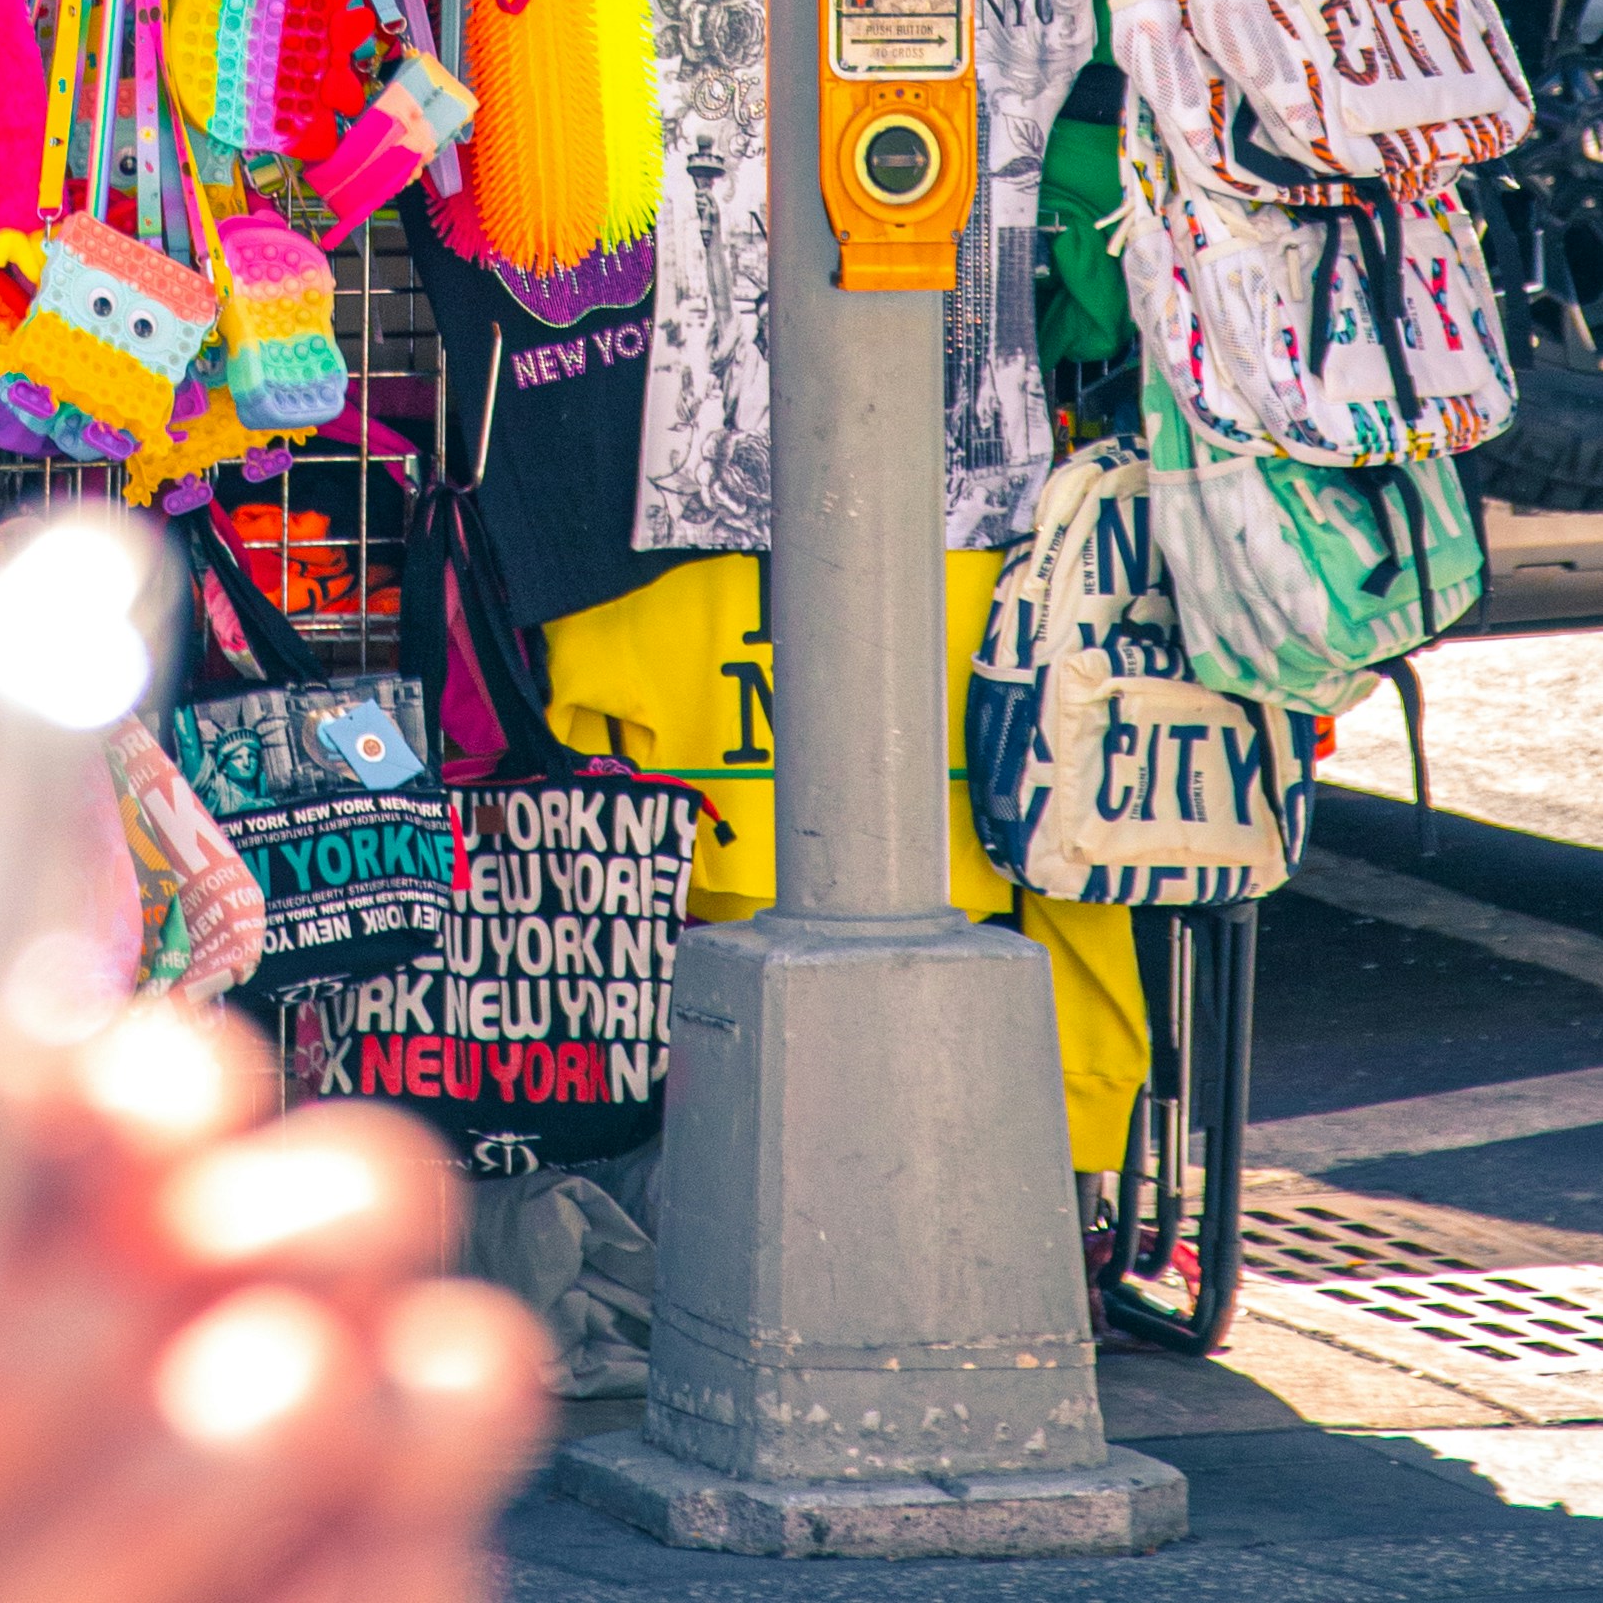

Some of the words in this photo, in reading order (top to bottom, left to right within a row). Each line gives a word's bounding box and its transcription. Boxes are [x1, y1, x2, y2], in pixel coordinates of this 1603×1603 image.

[865, 25, 893, 36] PUSH
[896, 25, 934, 36] BUTTON
[874, 47, 888, 58] TO
[891, 47, 925, 59] CROSS
[511, 336, 587, 391] NEW
[592, 317, 654, 368] YO
[1097, 721, 1260, 827] CITY
[245, 813, 290, 832] YORK
[294, 806, 331, 825] NEW
[332, 799, 376, 818] YORK
[280, 824, 416, 892] YORK
[267, 888, 345, 912] TATUEOFLIBERTY
[286, 907, 318, 923] YORK
[320, 902, 347, 915] NEW
[347, 897, 374, 912] YORK
[298, 915, 353, 948] NEW
[444, 977, 552, 1042] NEW
[359, 1033, 483, 1102] NEW
[487, 1039, 611, 1104] YORK
